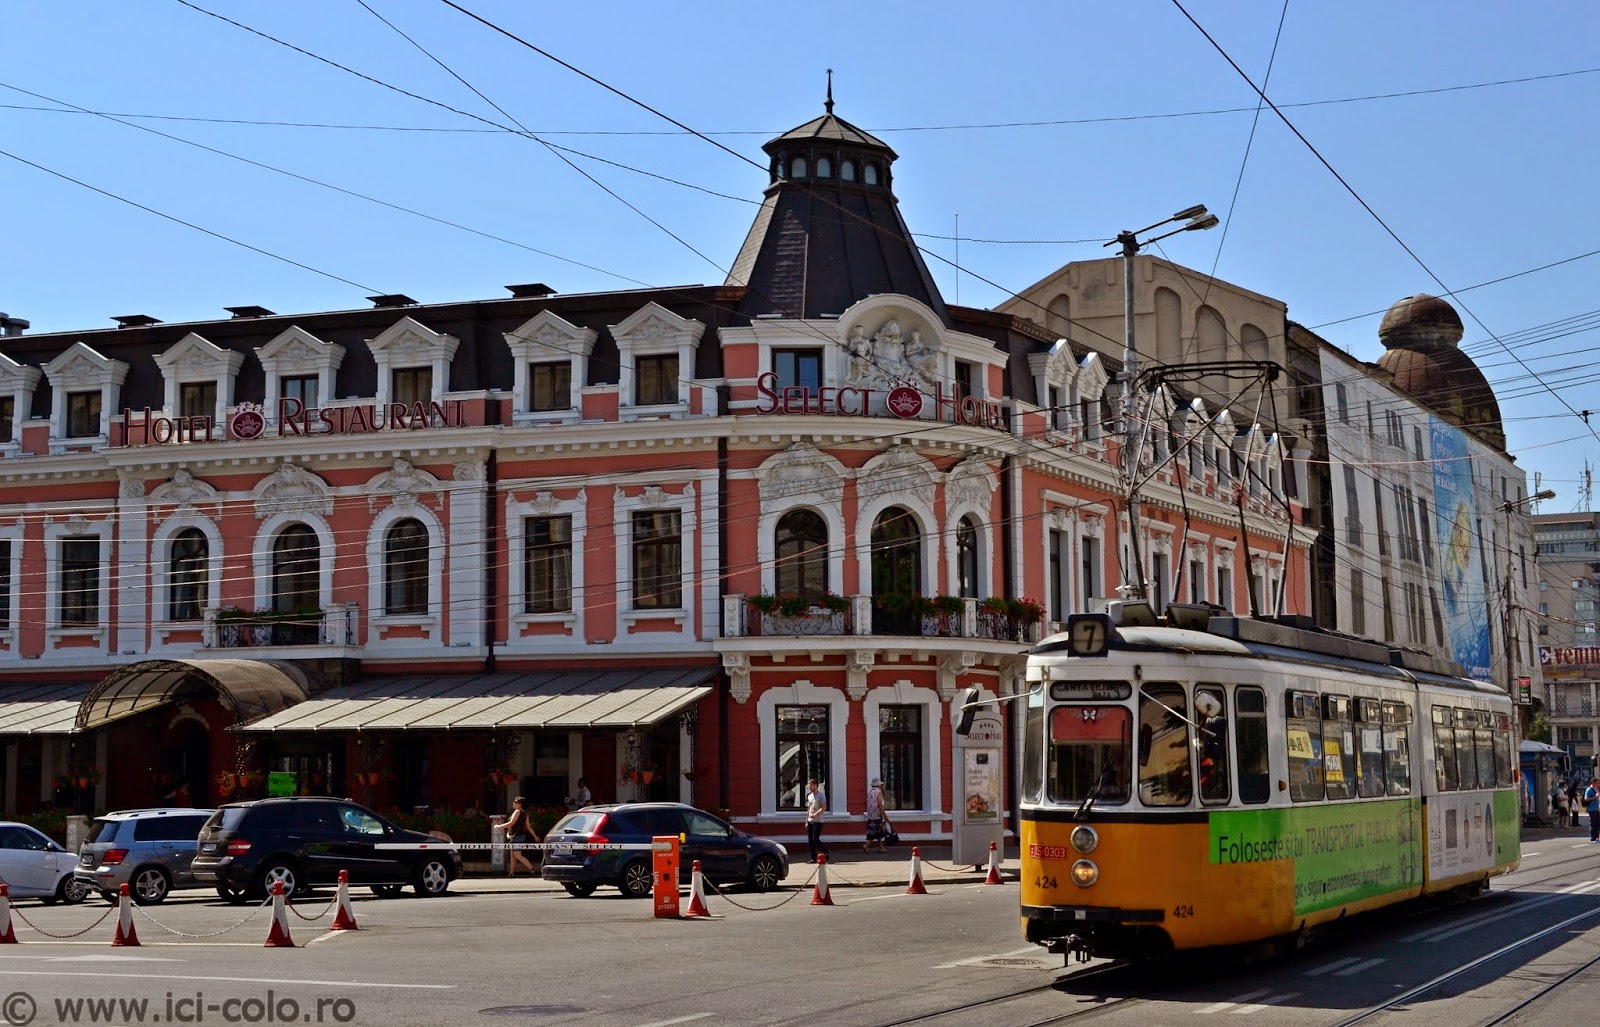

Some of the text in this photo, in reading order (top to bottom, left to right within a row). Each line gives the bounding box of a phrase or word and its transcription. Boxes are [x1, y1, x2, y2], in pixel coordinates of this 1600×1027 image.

[756, 371, 1007, 430] SELECT HOTEL
[124, 397, 468, 447] HOTEL RESTAURANT
[1083, 624, 1097, 651] 7
[1305, 823, 1365, 856] TRANSPORTUL
[1034, 876, 1059, 889] 424
[1173, 905, 1195, 918] 424
